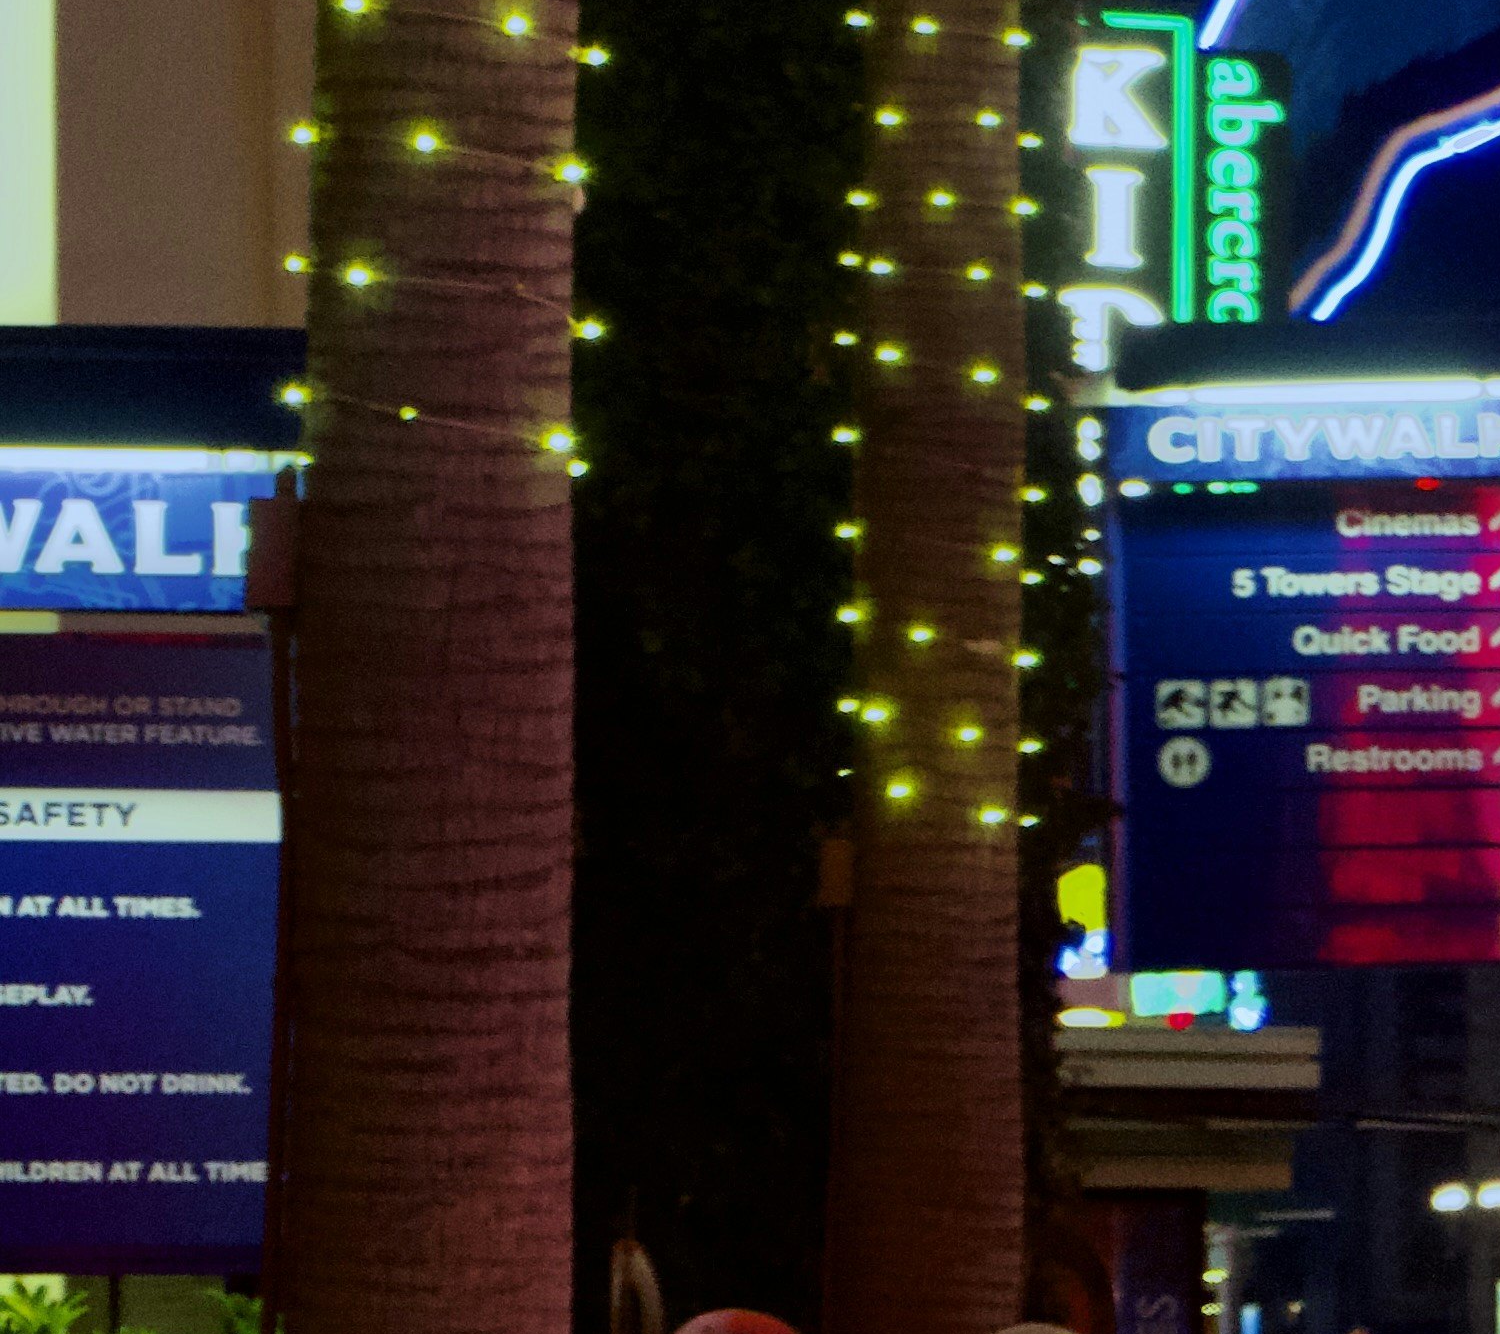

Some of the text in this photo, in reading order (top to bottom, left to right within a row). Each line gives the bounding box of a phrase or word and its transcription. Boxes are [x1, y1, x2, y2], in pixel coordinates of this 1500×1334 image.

[1336, 509, 1480, 537] Cinemas
[1232, 564, 1481, 601] 5 Towers Stage
[1292, 625, 1481, 655] Quick Food
[114, 696, 150, 717] OR
[1358, 684, 1481, 719] Parking
[50, 724, 138, 744] WATER
[1306, 743, 1483, 773] Restrooms
[16, 896, 54, 917] AT
[57, 896, 108, 917] ALL
[112, 896, 202, 918] TIMES.
[53, 1072, 95, 1095] DO
[100, 1072, 156, 1095] NOT
[161, 1072, 251, 1096] DRINK.
[108, 1161, 143, 1184] AT
[148, 1161, 199, 1184] ALL
